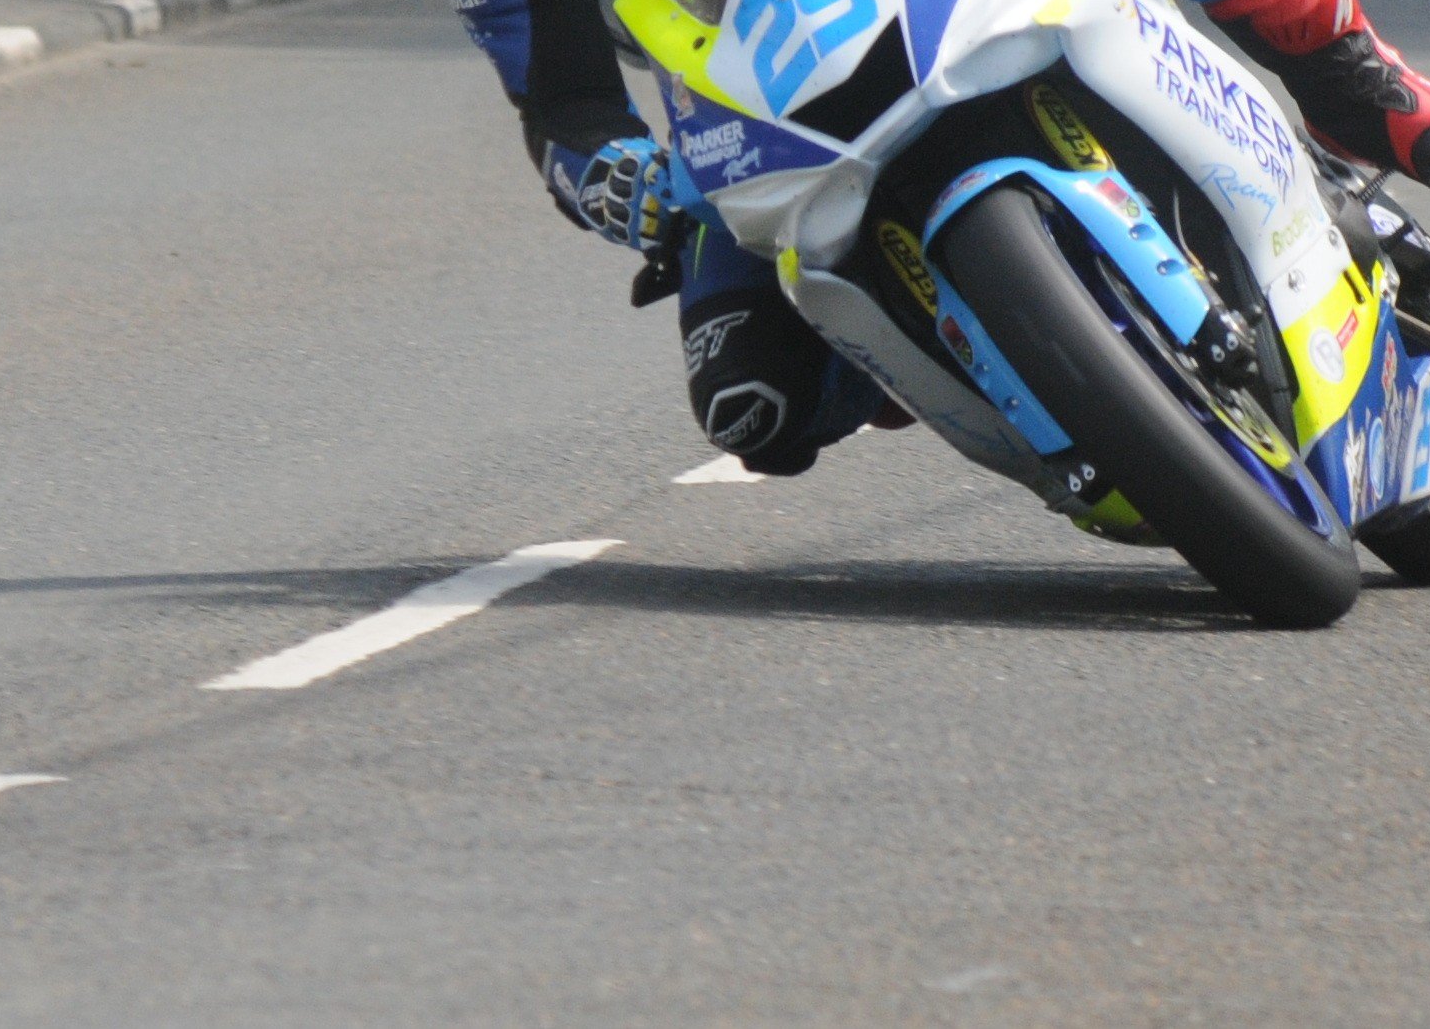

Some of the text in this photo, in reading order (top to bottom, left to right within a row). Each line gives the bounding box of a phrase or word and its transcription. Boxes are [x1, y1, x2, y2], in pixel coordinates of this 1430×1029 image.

[684, 120, 746, 160] PARKER
[1151, 56, 1291, 204] TRANSPORT
[1196, 162, 1278, 225] Racing
